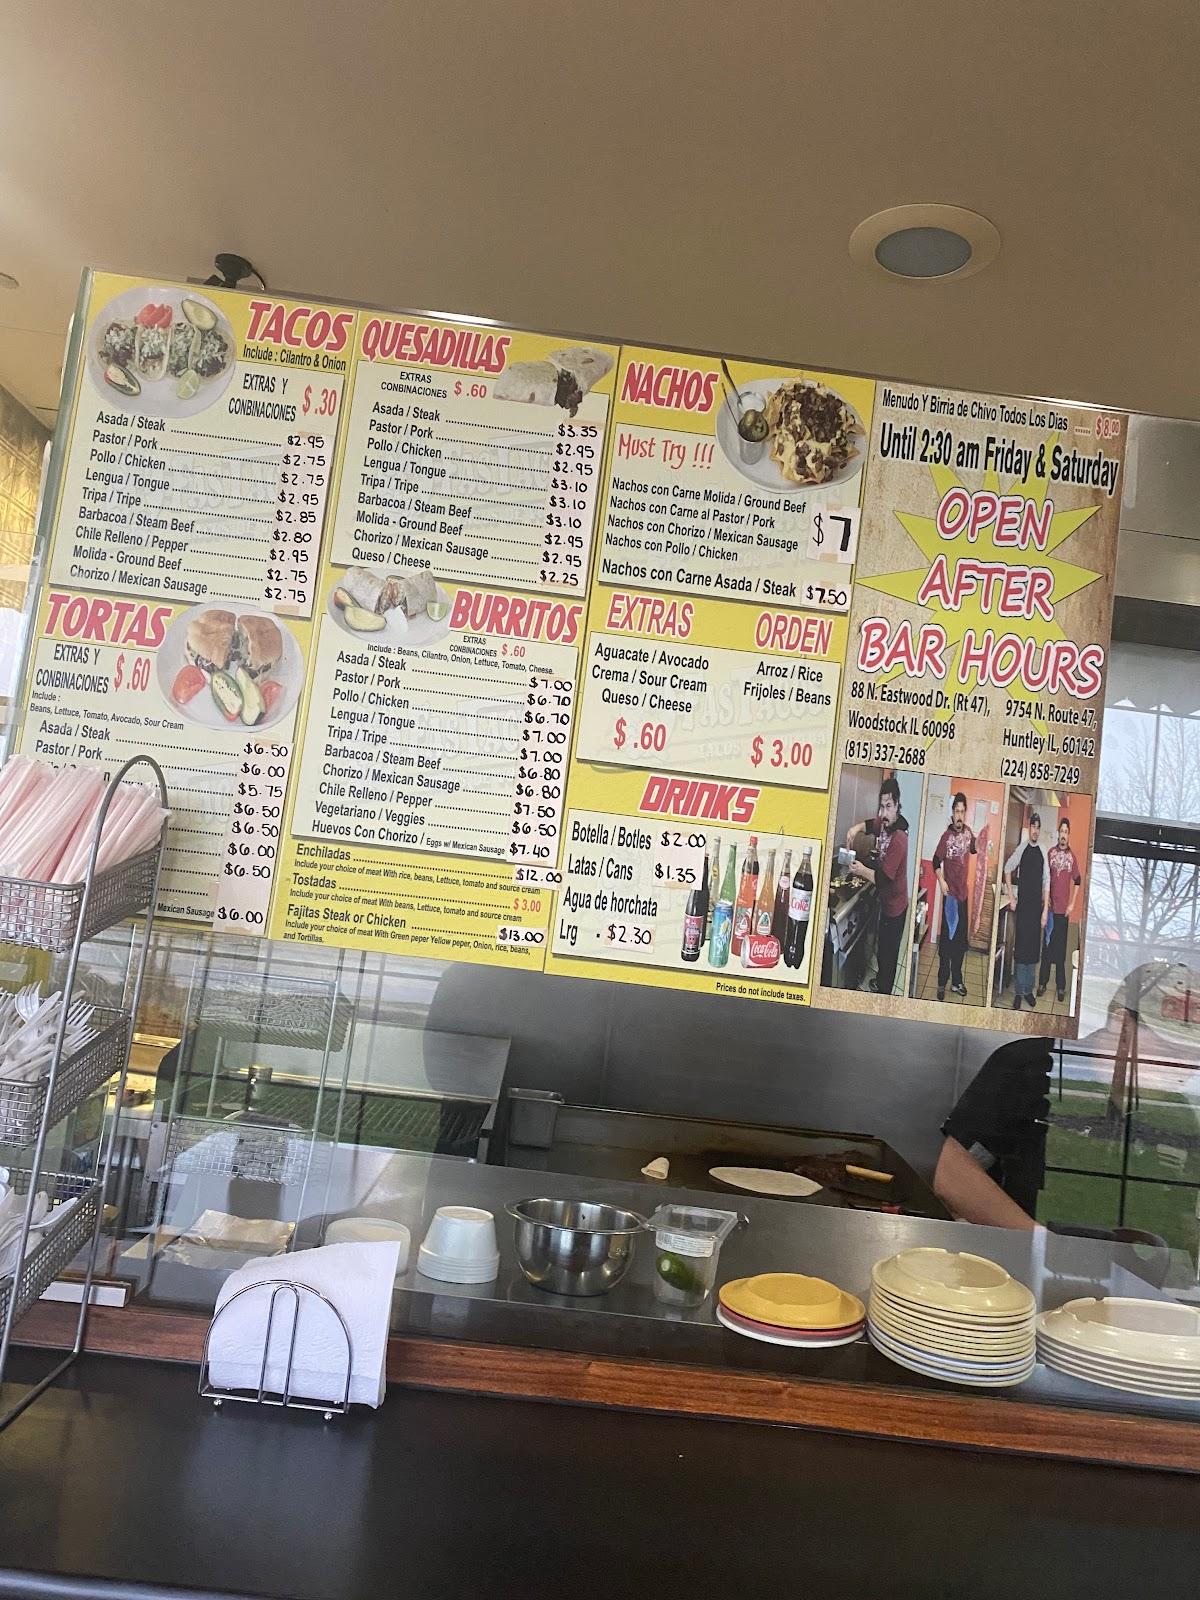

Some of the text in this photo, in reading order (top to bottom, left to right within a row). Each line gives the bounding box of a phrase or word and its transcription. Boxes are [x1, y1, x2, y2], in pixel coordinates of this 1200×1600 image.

[247, 301, 352, 351] TACOS
[242, 343, 346, 371] Include Cilantro & Onion
[362, 319, 510, 373] QUESADILLAS
[242, 372, 288, 395] EXTRAS Y
[380, 381, 447, 398] CONBINACIONES
[399, 371, 431, 384] EXTRAS
[621, 363, 718, 412] NACHOS
[228, 397, 296, 422] CONBINACIONES
[371, 401, 440, 422] Asada Steak
[882, 388, 919, 410] Menudo
[921, 393, 929, 412] Y
[929, 395, 954, 415] Birria
[956, 399, 968, 417] de
[970, 400, 997, 421] Chivo
[999, 404, 1026, 425] Todos
[1028, 408, 1046, 428] Los
[95, 410, 165, 432] Asada Steak
[557, 423, 598, 438] $3.35
[92, 429, 158, 450] Pastor Pork
[287, 435, 324, 448] $2.95
[366, 436, 441, 458] Pollo Chicken
[616, 432, 687, 470] Must Try
[89, 448, 166, 470] Pollo Chicken
[282, 453, 325, 466] $2.75
[552, 460, 593, 476] $2.95
[880, 422, 1118, 496] Until 2:30 am Friday & Saturday
[612, 476, 806, 513] Nachos con Carne Molida Ground Beef
[275, 509, 316, 523] $2.85
[356, 510, 463, 536] Molida Ground Beef
[938, 491, 1051, 545] OPEN
[607, 513, 798, 552] Nachos con Chorizo Mexican Sausage
[351, 546, 431, 569] Queso Cheese
[69, 563, 207, 596] Chorizo Mexican Sausage
[539, 569, 578, 586] $2.25
[919, 558, 1052, 617] AFTER
[806, 584, 847, 606] $7.50
[46, 593, 171, 647] TORTAS
[449, 591, 582, 643] BURRITOS
[606, 593, 693, 638] EXTRAS
[462, 635, 486, 645] EXTRAS
[755, 612, 832, 654] ORDEN
[53, 643, 100, 665] EXTRAS Y
[366, 643, 392, 654] Include
[448, 644, 497, 657] CONBINACIONES
[594, 642, 709, 670] Aguacate Avocado
[859, 621, 1102, 695] BAR HOURS
[35, 668, 109, 694] CONBINACIONES
[591, 664, 707, 692] Crema Sour Cream
[756, 660, 823, 682] Arroz Rice
[601, 687, 692, 713] Queso Cheese
[743, 681, 831, 706] Frijoles Beans
[330, 706, 415, 730] Lengua Tongue
[848, 709, 955, 740] Woodstock IL 60098
[1005, 699, 1099, 729] 9754 N. Route 47,
[39, 719, 110, 741] Asada Steak
[243, 742, 288, 757] $6.50
[844, 739, 928, 766] (815) 337-2688
[1002, 728, 1097, 758] Huntley IL, 60142
[240, 761, 285, 778] $6.00
[1000, 757, 1081, 787] (224) 858-7249
[237, 782, 283, 798] $5.75
[318, 781, 433, 808] Chile Relleno Pepper
[640, 776, 759, 823] DRINKS
[315, 800, 425, 827] Vegetariano Veggies
[513, 801, 555, 818] $7.50
[511, 820, 556, 837] $6.50
[571, 820, 652, 850] Botella Botles
[660, 830, 706, 848] $2.00
[295, 842, 351, 861] Enchiladas
[509, 841, 550, 858] $7.40
[515, 868, 562, 883] $12.00
[567, 853, 633, 881] Latas Cans
[654, 862, 696, 884] $1.35
[292, 872, 336, 889] Tostadas
[156, 902, 215, 919] Mexican Sausage
[562, 886, 658, 917] Agua de horchata
[287, 903, 406, 928] Fajitas Steak or Chicken
[498, 927, 544, 944] $13.00
[559, 918, 578, 946] Lrg
[607, 923, 652, 945] $2.30
[715, 981, 736, 993] Prices
[737, 985, 747, 994] do
[748, 987, 759, 996] not
[760, 987, 784, 999] include
